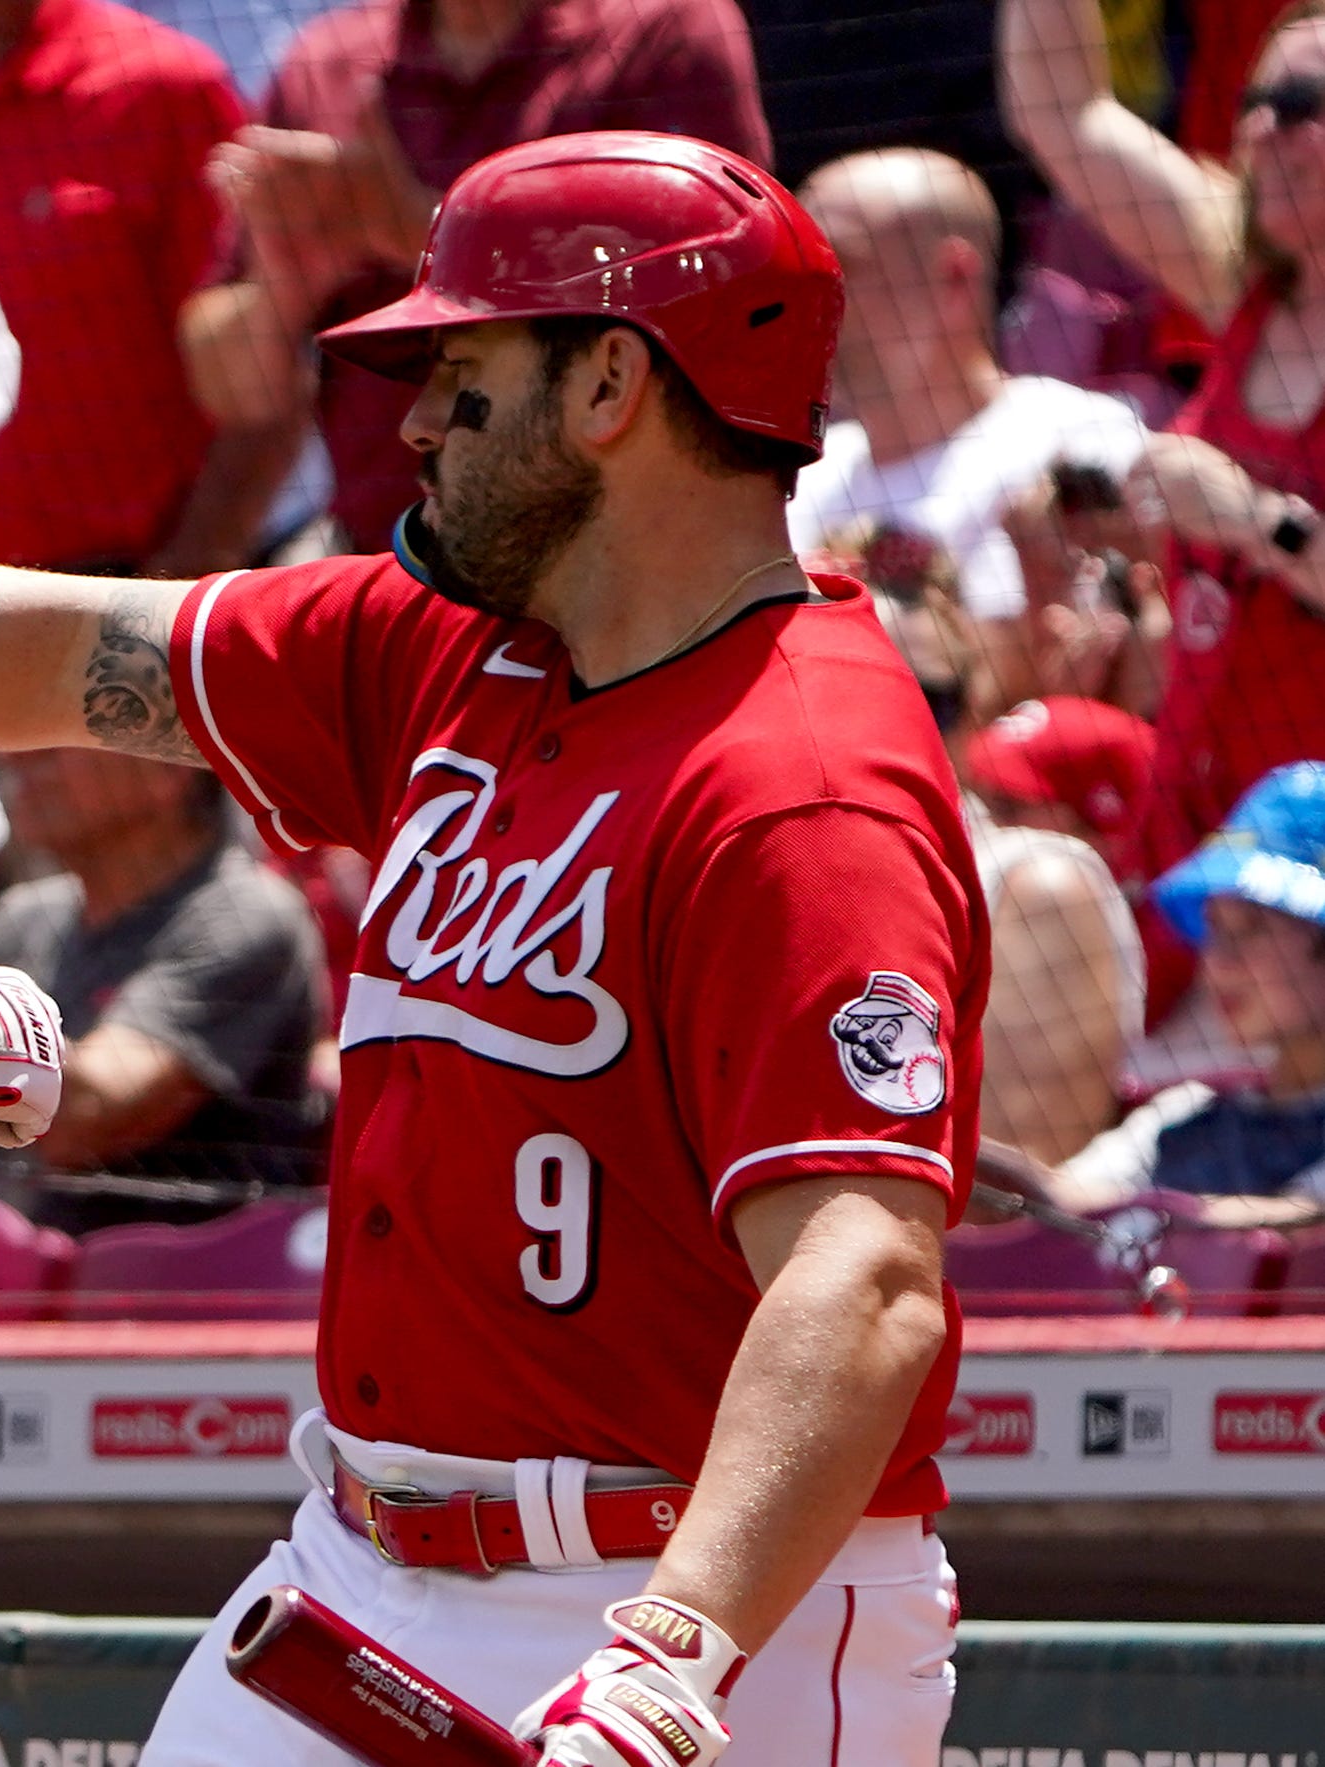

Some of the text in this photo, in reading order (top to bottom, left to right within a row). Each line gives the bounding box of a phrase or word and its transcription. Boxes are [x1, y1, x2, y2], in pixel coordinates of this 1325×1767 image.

[338, 747, 630, 1078] Reds
[515, 1132, 599, 1313] 9
[650, 1500, 676, 1531] 9
[630, 1602, 700, 1649] MM9
[609, 1685, 696, 1756] marucci
